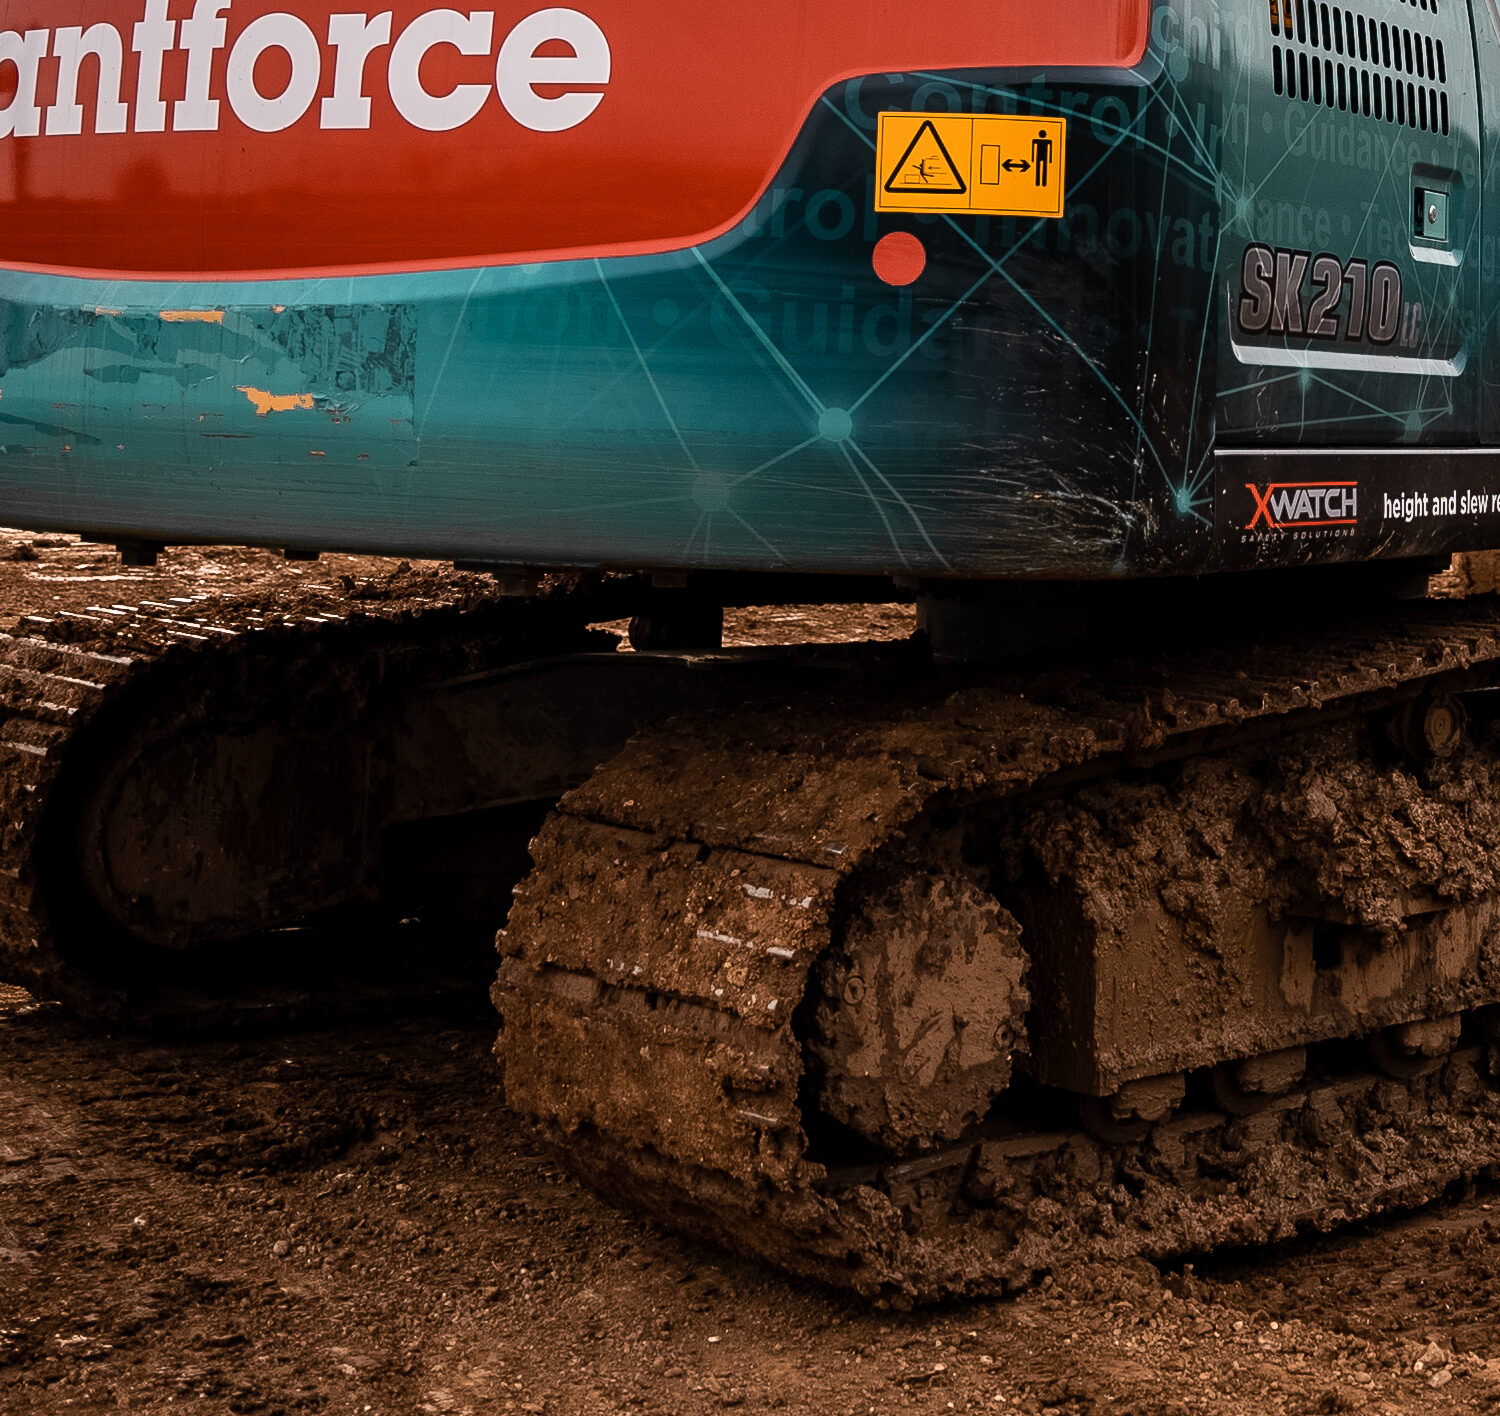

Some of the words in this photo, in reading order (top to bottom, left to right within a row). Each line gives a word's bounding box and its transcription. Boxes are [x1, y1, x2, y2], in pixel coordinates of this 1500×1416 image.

[1238, 245, 1402, 345] SK210
[1246, 481, 1358, 530] XWATCH
[1383, 492, 1429, 523] height
[1432, 489, 1457, 517] and
[1460, 489, 1488, 514] slew
[1240, 531, 1286, 543] SAFETY
[1293, 527, 1356, 539] SOLUTIONS
